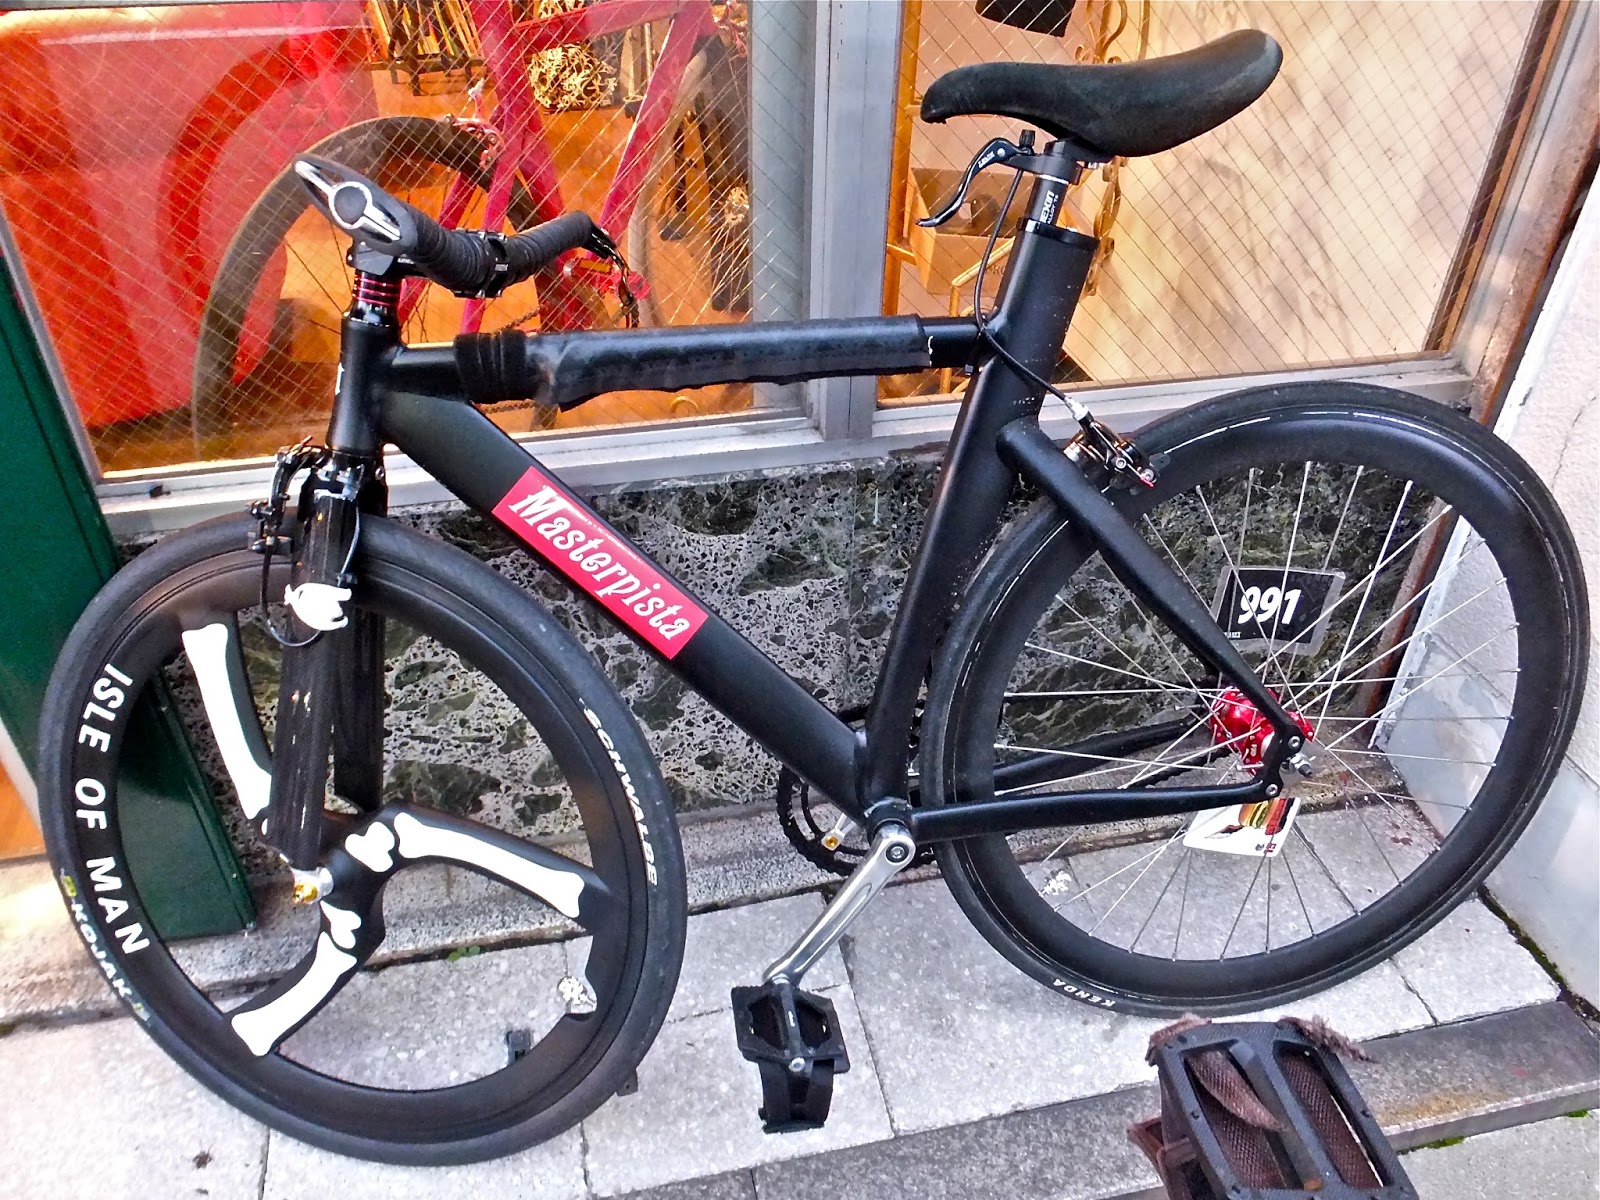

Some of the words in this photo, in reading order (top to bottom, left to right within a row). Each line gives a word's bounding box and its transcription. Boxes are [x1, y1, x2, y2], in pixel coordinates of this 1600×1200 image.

[508, 484, 691, 641] Masterpista
[1237, 586, 1302, 625] 991
[78, 663, 133, 753] ISLE
[75, 777, 108, 830] OF
[583, 707, 658, 886] SCHWALBE
[71, 903, 133, 998] KOJAK
[86, 856, 150, 955] MAN
[1053, 978, 1116, 1007] KENDA
